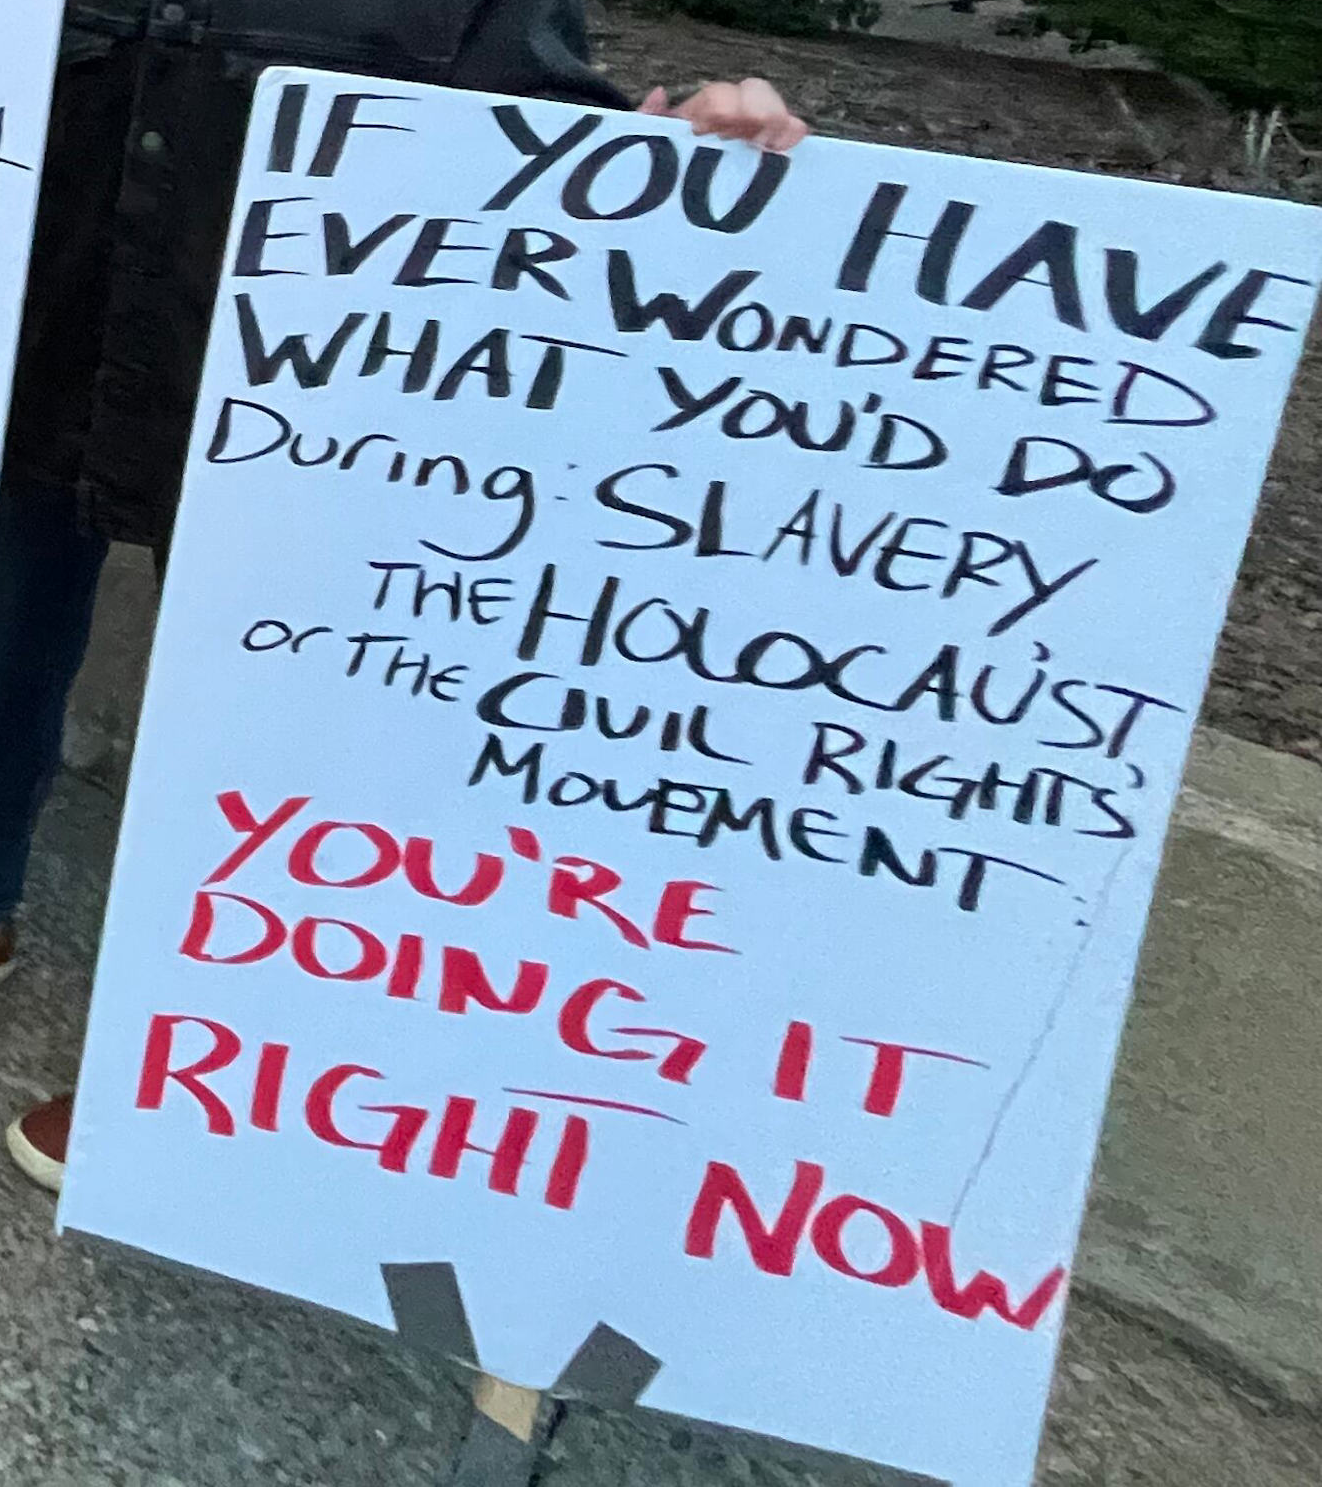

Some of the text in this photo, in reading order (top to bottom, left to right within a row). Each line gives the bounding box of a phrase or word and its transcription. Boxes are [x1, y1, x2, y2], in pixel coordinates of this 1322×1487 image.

[232, 196, 1217, 427] EVER WONDERED
[266, 83, 1312, 359] IF YOU HAVE
[234, 293, 1178, 514] WHAT YOU'D DO
[346, 632, 471, 702] THE
[475, 671, 755, 765] CIVIL
[367, 561, 515, 625] THE
[201, 789, 743, 956] YOU'RE
[178, 889, 992, 1118] DOING IT
[134, 1012, 1067, 1331] RIGHT NOW
